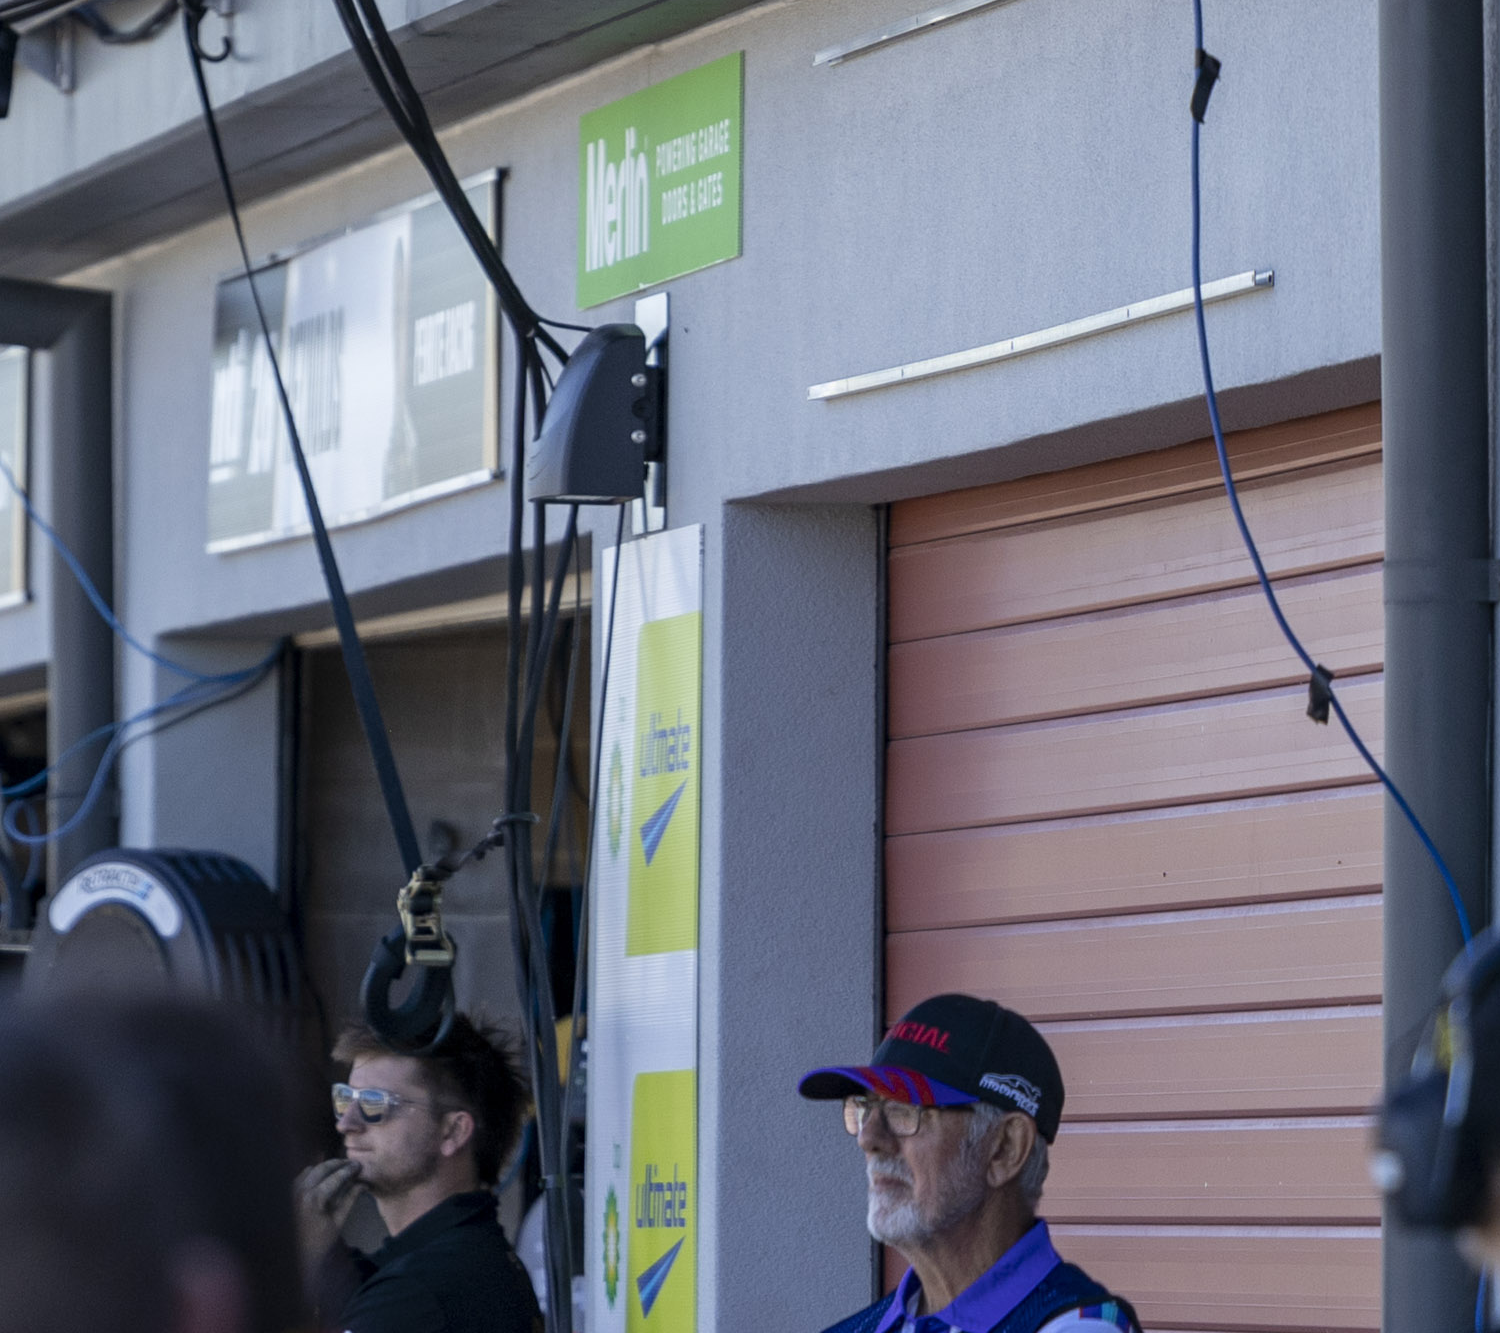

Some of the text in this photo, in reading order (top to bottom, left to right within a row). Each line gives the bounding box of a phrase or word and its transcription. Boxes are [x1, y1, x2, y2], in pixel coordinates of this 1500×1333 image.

[584, 118, 730, 273] Merlin POWERING GARAGE
[698, 171, 722, 212] GATES
[640, 706, 691, 778] ultimate
[636, 1163, 687, 1228] ultimate
